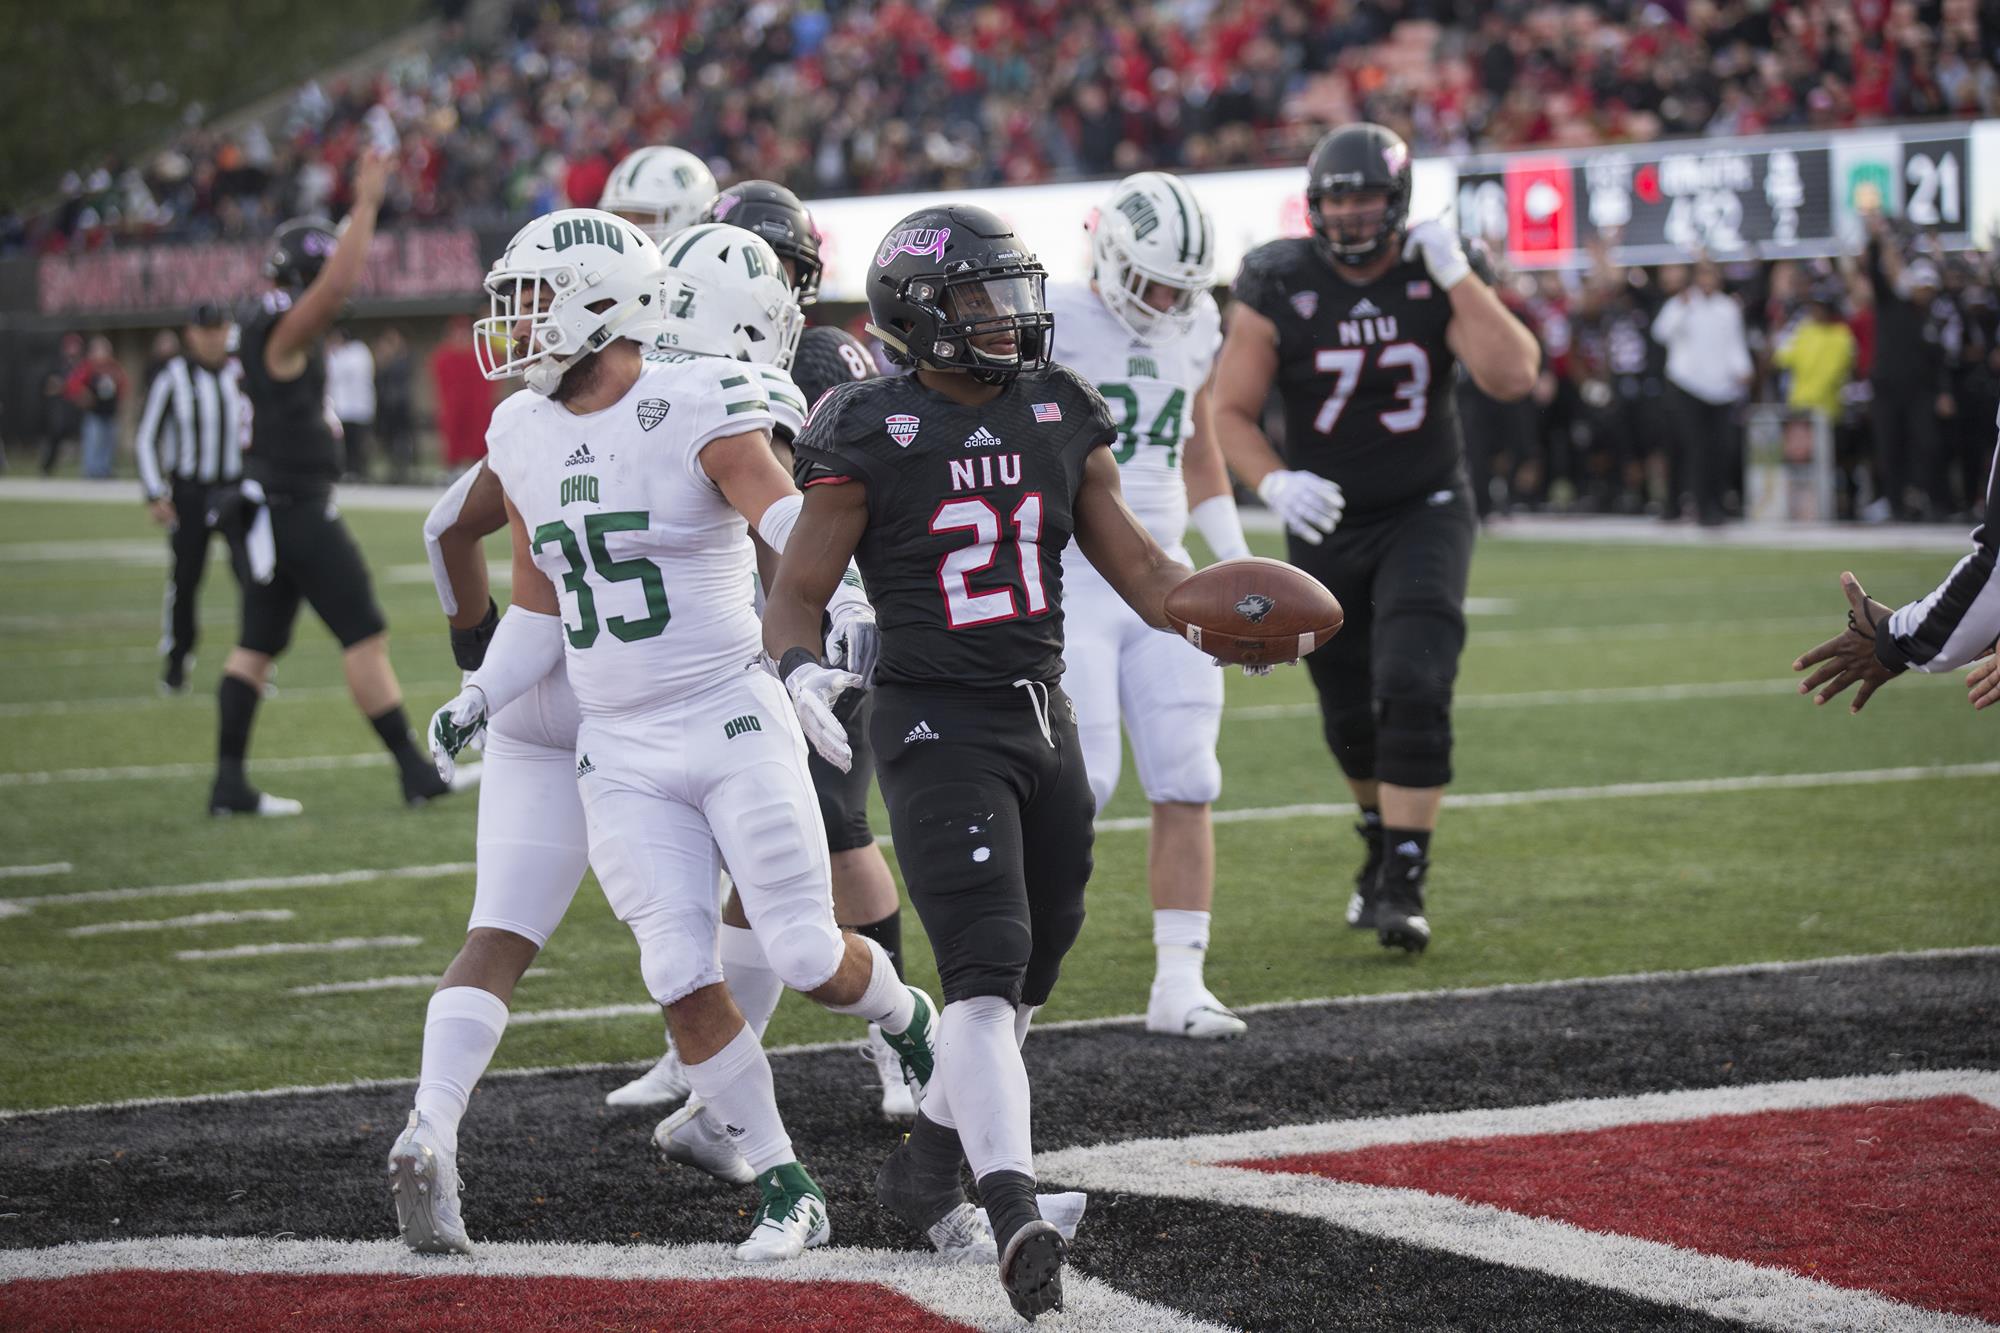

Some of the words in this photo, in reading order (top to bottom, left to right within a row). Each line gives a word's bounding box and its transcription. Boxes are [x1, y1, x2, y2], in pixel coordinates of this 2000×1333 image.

[552, 218, 623, 254] OHIO
[676, 289, 695, 319] 7
[1337, 315, 1399, 346] NIU
[1313, 341, 1431, 435] 73
[887, 423, 920, 434] MAC
[1097, 383, 1185, 469] 34
[964, 437, 1002, 448] adidas
[564, 455, 596, 467] adidas
[948, 453, 1023, 491] NIU
[561, 474, 600, 507] OHIO
[928, 492, 1050, 631] 21
[532, 510, 672, 650] 35
[723, 715, 762, 740] OHIO
[904, 732, 940, 744] adidas
